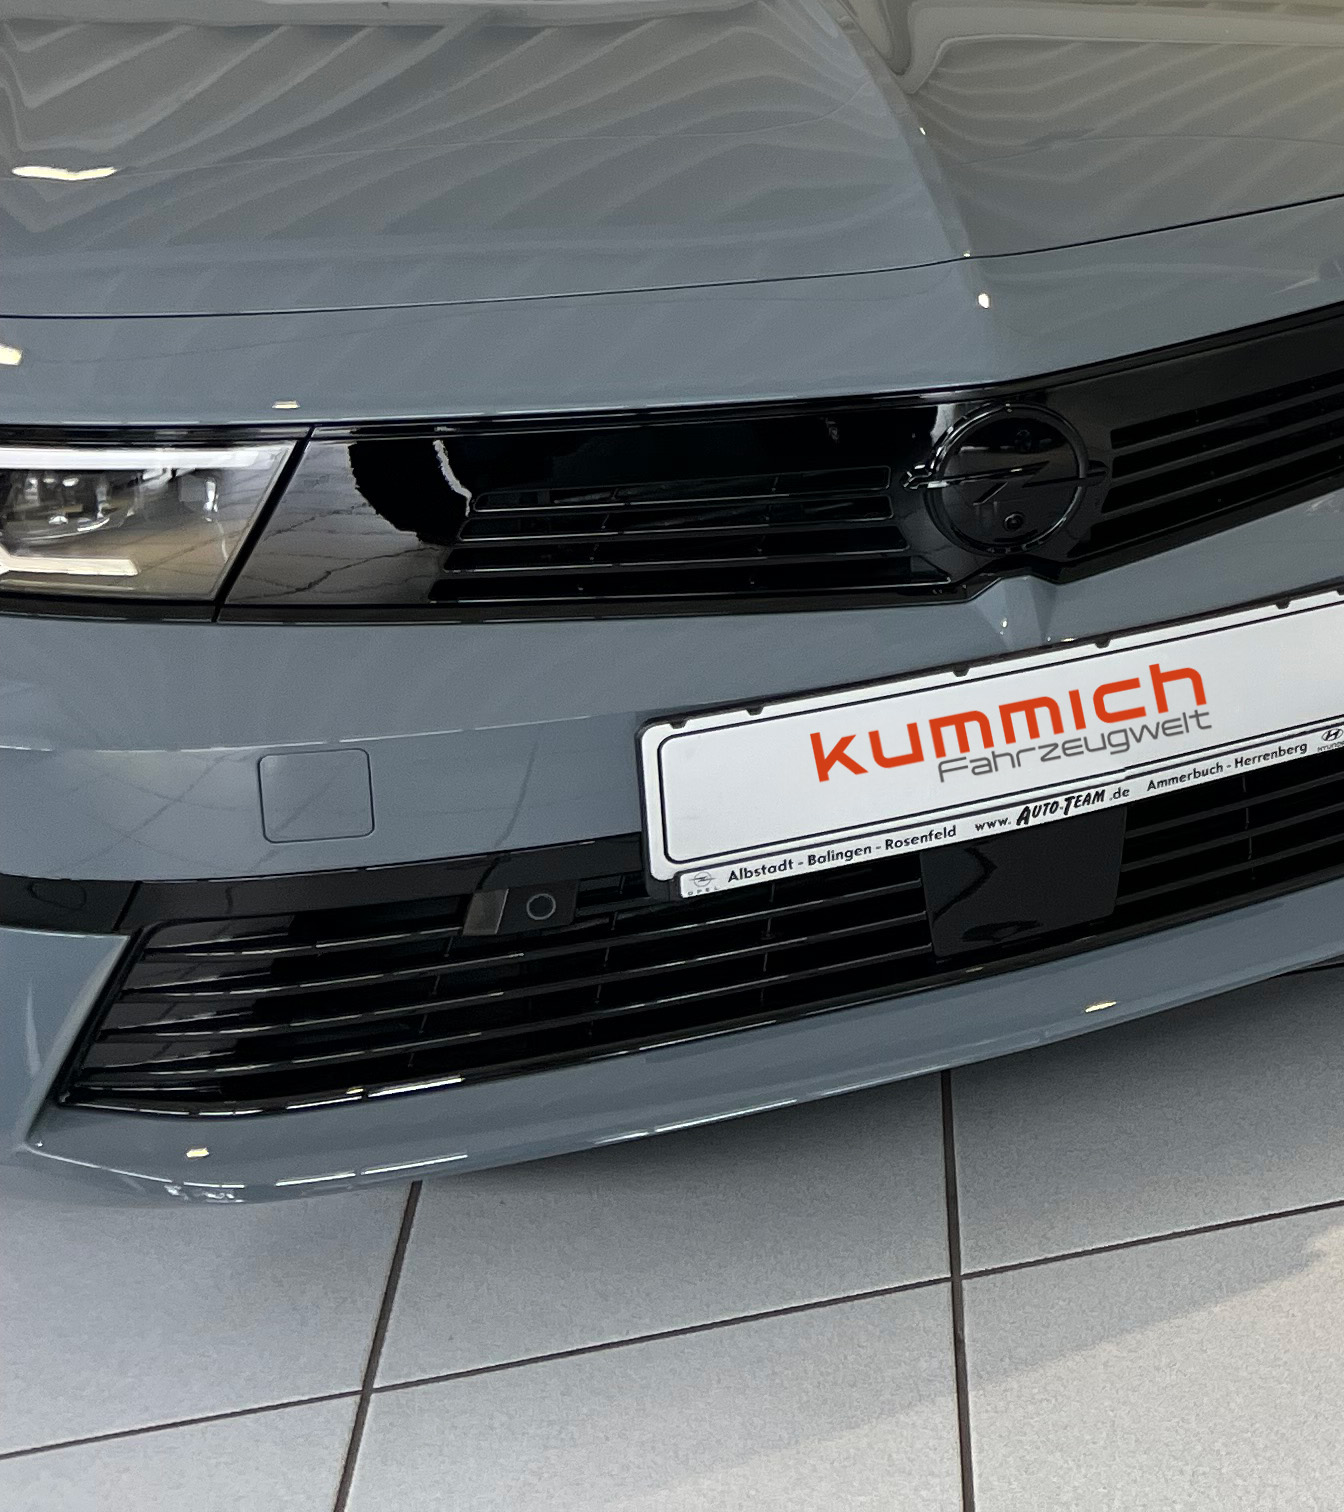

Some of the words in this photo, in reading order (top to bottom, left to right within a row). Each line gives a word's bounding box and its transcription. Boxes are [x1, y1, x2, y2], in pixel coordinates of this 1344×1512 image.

[937, 709, 1213, 783] Fahrzeugwelt
[727, 858, 794, 883] Albstadt
[807, 845, 872, 866] Balingen
[885, 825, 957, 851] Rosenfeld
[1146, 762, 1224, 791] Ammerbuch
[1234, 743, 1308, 769] Herrenberg
[687, 886, 719, 896] OPEL
